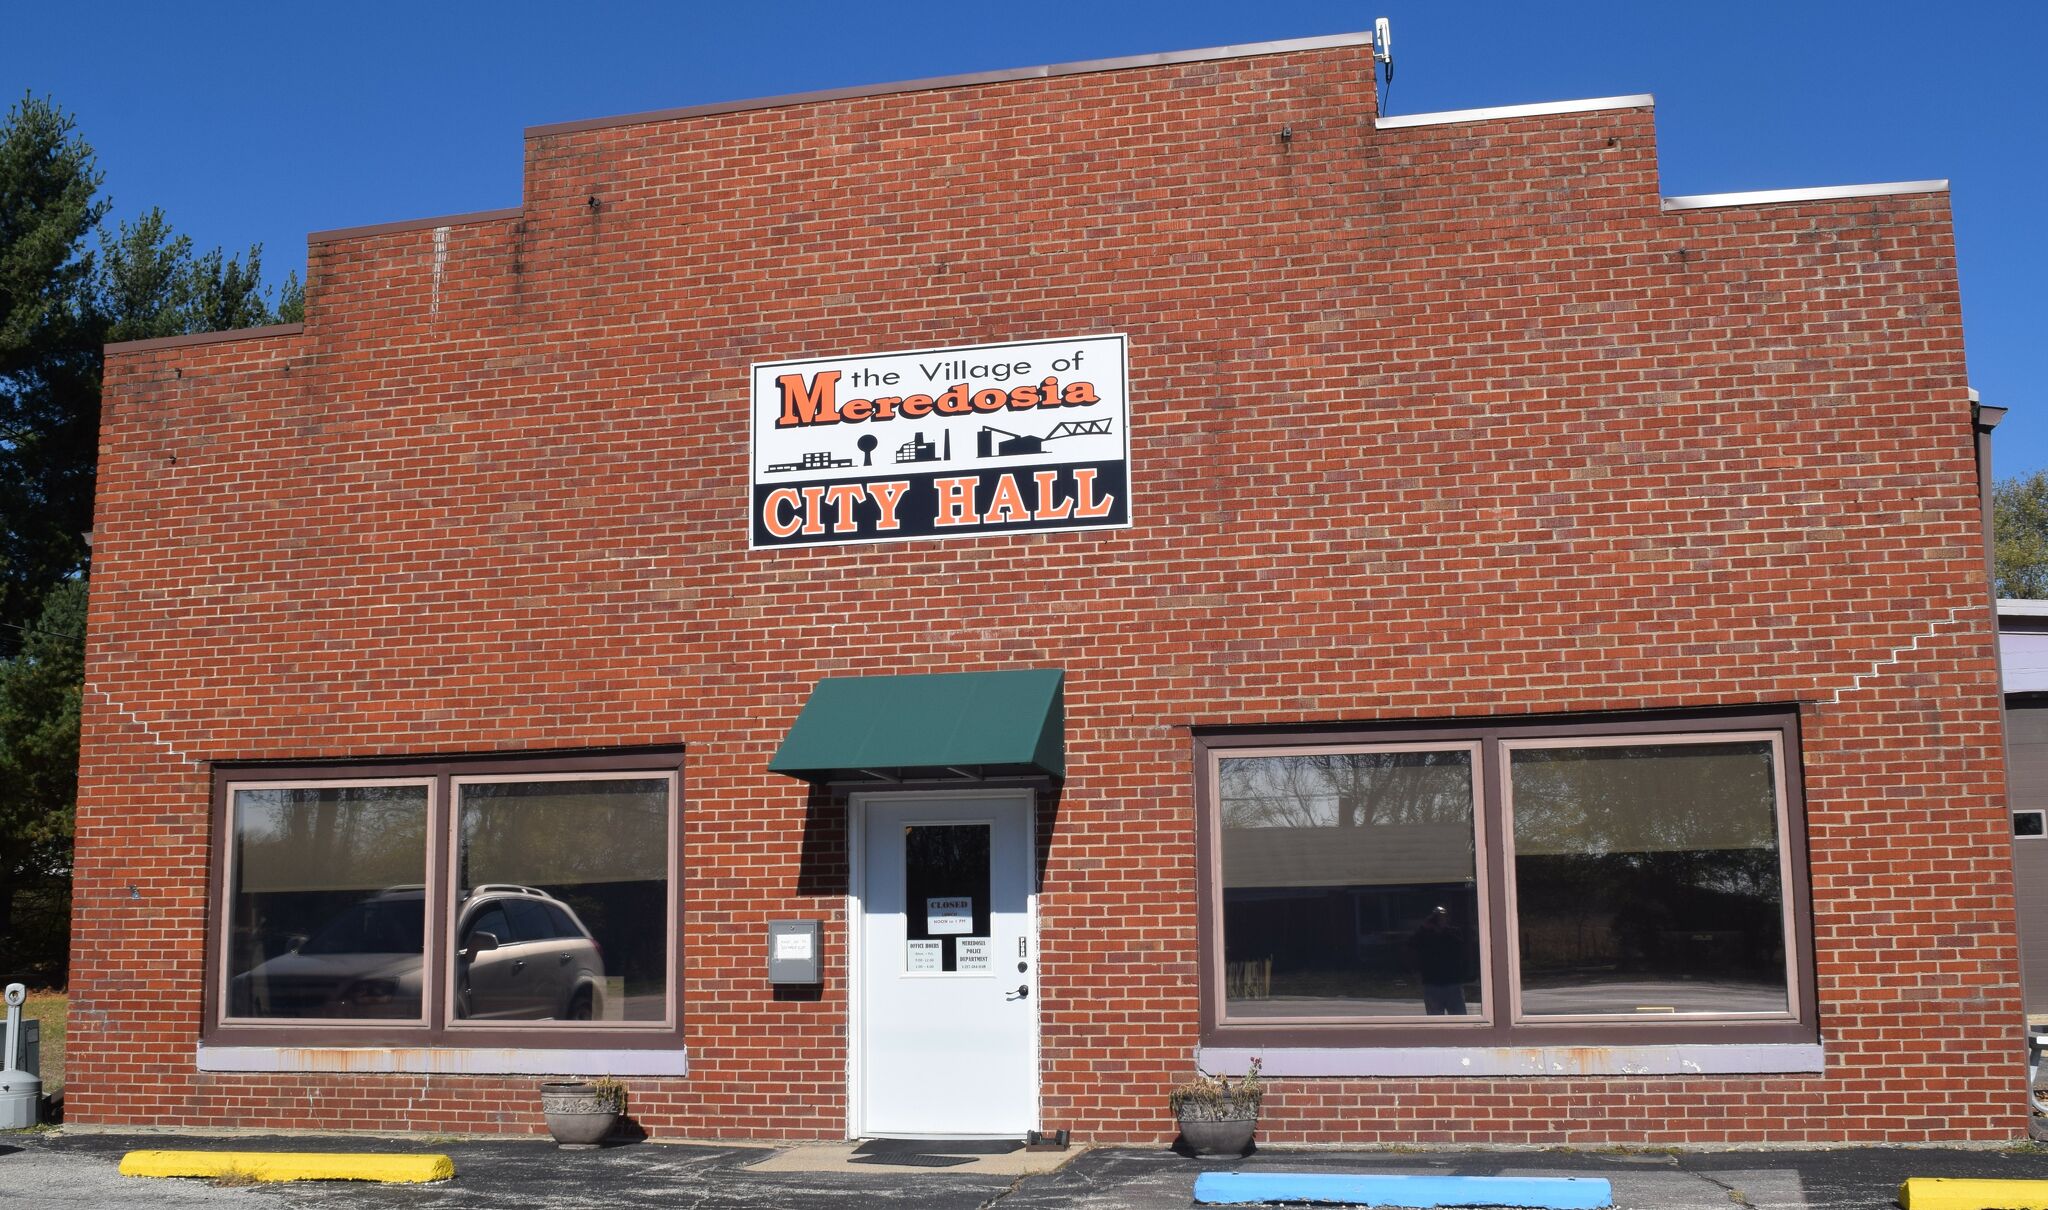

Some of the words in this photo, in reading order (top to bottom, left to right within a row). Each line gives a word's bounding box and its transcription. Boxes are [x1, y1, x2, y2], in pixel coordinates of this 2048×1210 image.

[851, 368, 900, 388] the
[919, 359, 1032, 382] Village
[1051, 350, 1085, 372] of
[775, 370, 1101, 429] Meredosia
[763, 480, 910, 538] CITY
[933, 467, 1114, 528] HALL
[930, 901, 968, 909] CLOSED
